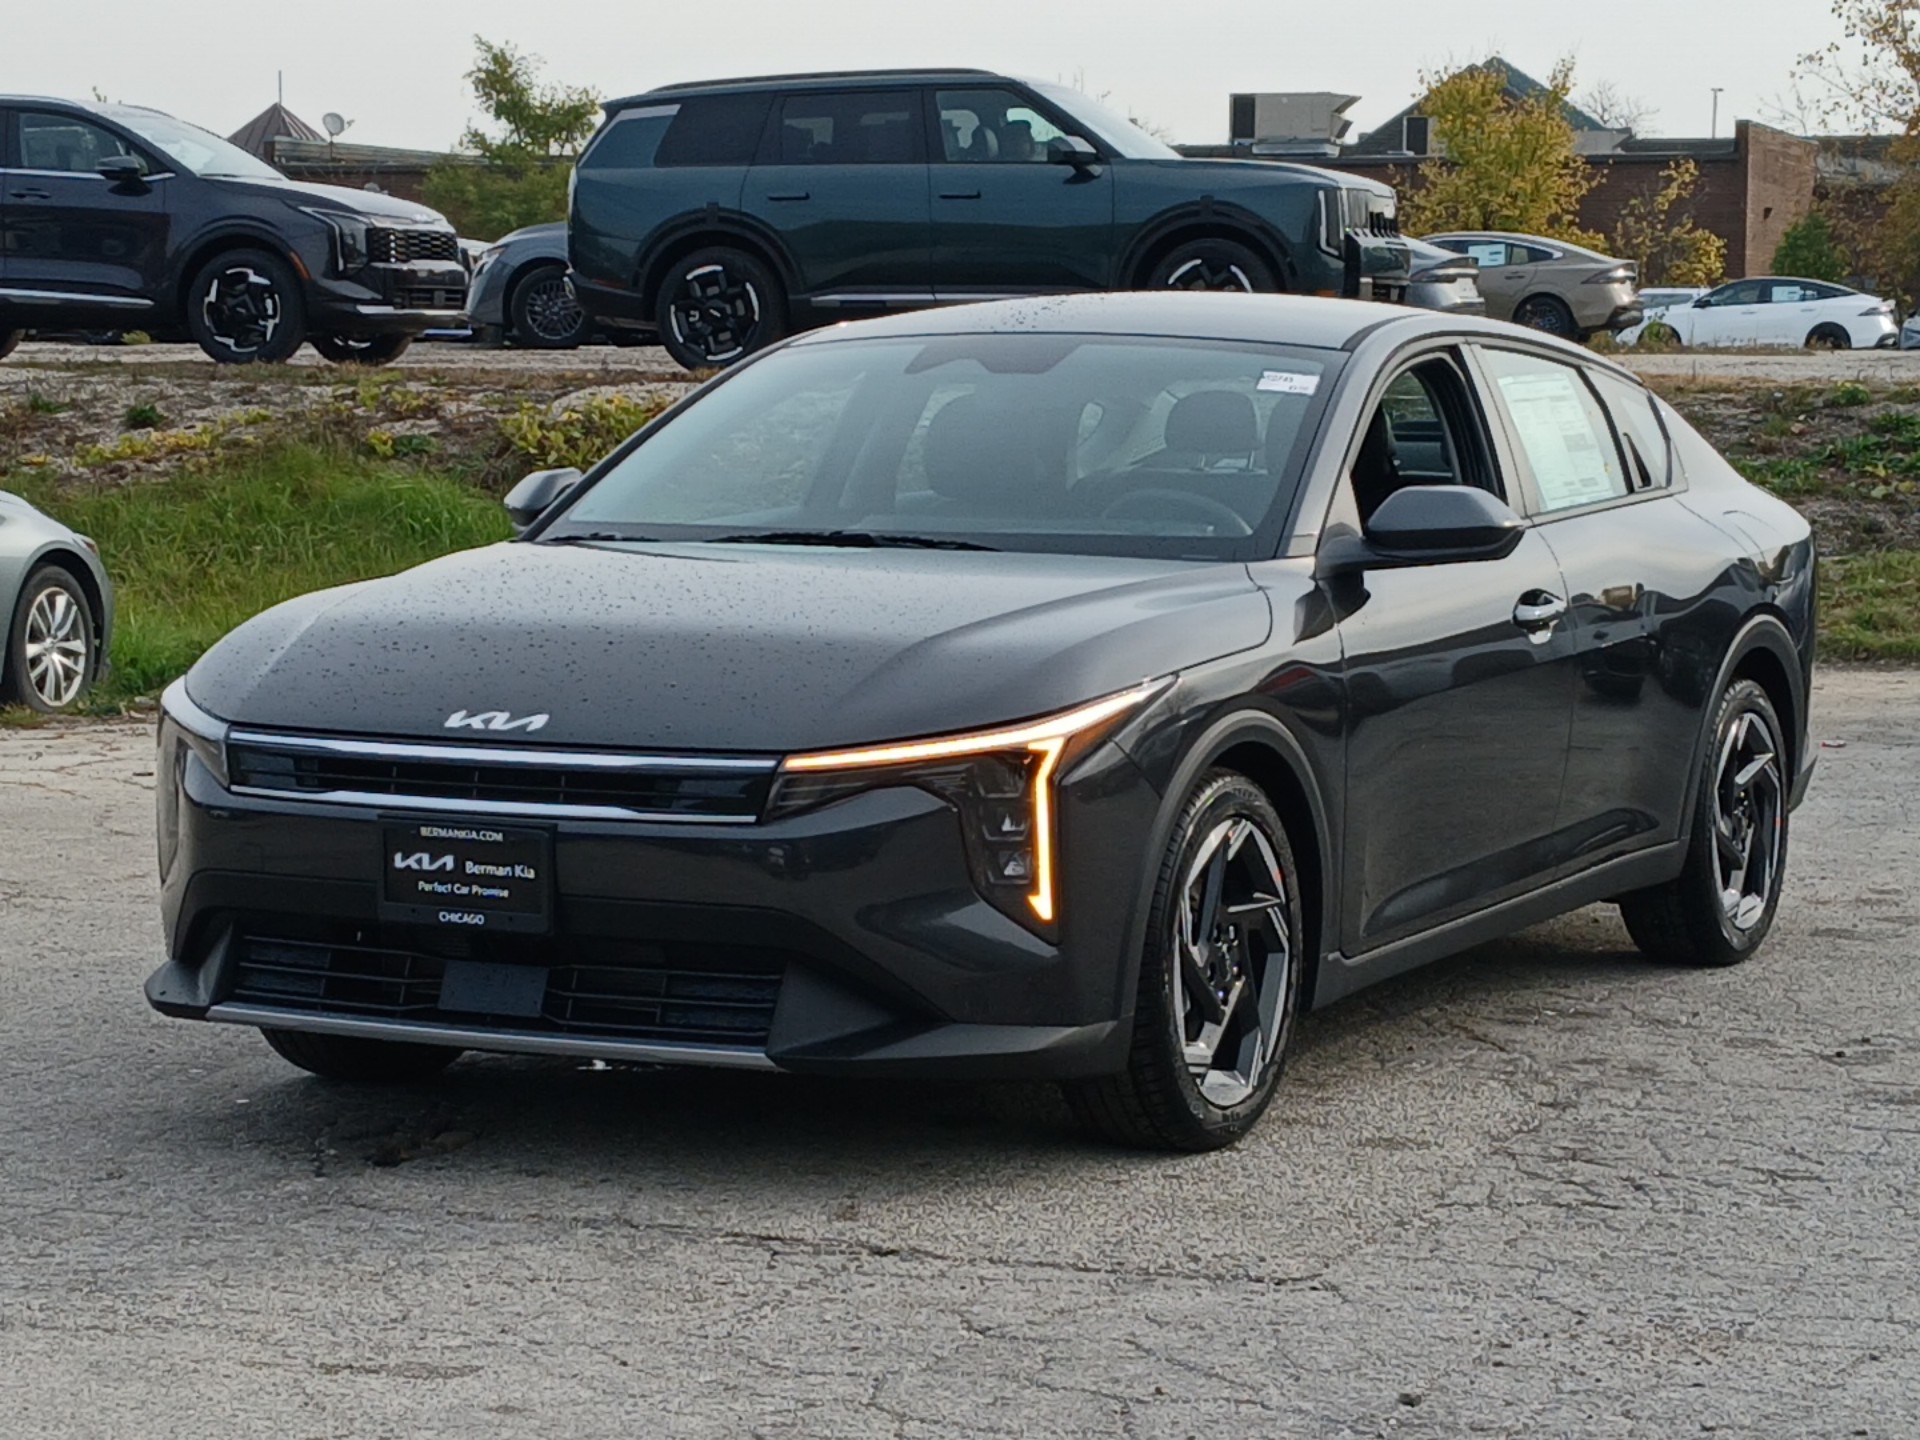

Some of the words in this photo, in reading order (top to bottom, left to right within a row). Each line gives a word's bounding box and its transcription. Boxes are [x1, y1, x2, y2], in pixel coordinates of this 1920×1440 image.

[444, 709, 550, 732] KIA
[420, 826, 504, 842] BERMANKIA.COM
[394, 851, 455, 871] KIA
[465, 860, 512, 877] Berman
[514, 865, 536, 879] Kia
[418, 880, 453, 893] Perfect
[453, 884, 470, 895] Car
[471, 885, 509, 899] Promise
[438, 911, 485, 925] CHICAGO
